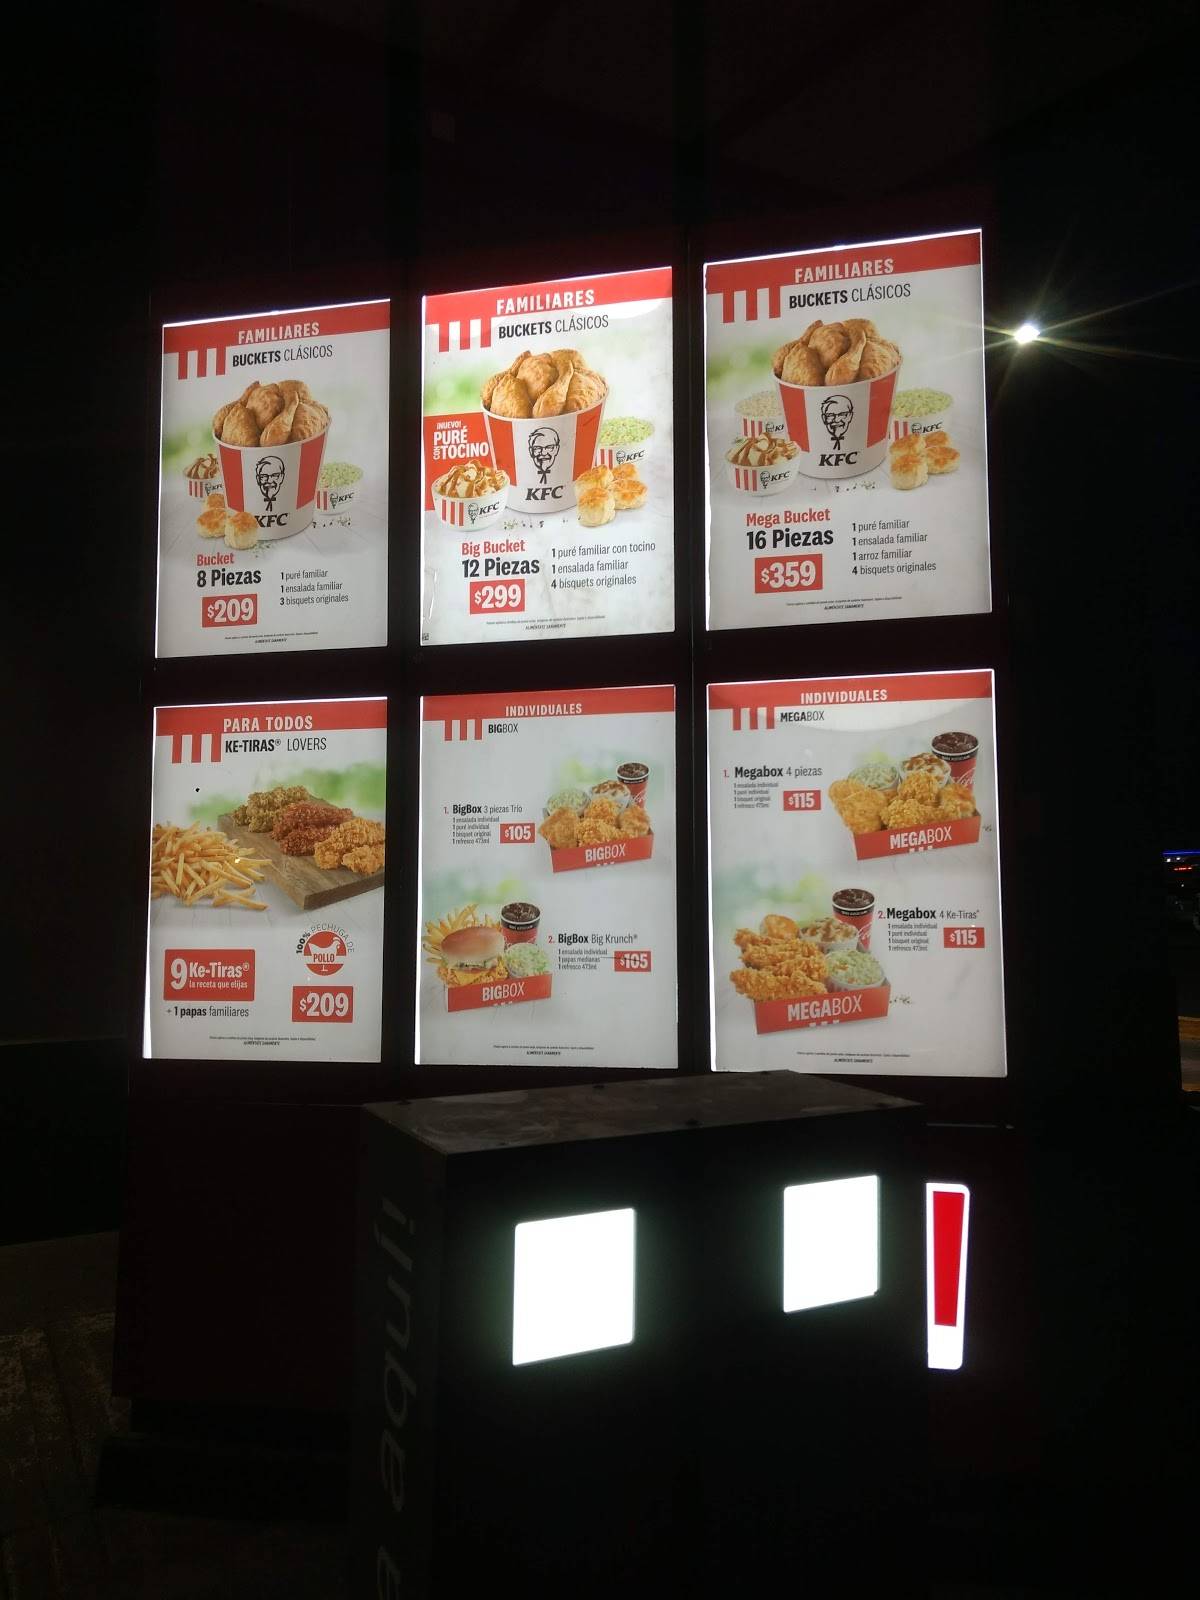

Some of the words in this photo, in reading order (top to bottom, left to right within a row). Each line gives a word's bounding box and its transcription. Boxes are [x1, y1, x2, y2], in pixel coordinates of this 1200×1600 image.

[794, 258, 894, 283] FAMILIARES
[496, 289, 595, 315] FAMILIARES
[789, 290, 848, 309] BUCKETS
[851, 283, 911, 303] CLÁSICOS
[238, 322, 320, 344] FAMILIARES
[499, 321, 552, 339] BUCKETS
[555, 314, 609, 333] CLÁSICOS
[232, 350, 281, 367] BUCKETS
[283, 345, 333, 361] CLÁSICOS
[433, 425, 468, 446] PURÉ
[921, 422, 943, 433] KFC
[433, 445, 441, 460] CON
[441, 442, 489, 460] TOCINO
[626, 450, 645, 461] KFC
[819, 452, 858, 467] KFC
[770, 471, 791, 481] KFC
[338, 492, 353, 502] KFC
[526, 485, 565, 501] KFC
[479, 502, 500, 515] KFC
[254, 513, 288, 528] KFC
[746, 513, 780, 528] Mega
[784, 508, 831, 524] Bucket
[852, 523, 856, 532] 1
[858, 520, 877, 532] puré
[878, 519, 910, 530] familiar
[746, 531, 767, 550] 16
[772, 528, 834, 549] Piezas
[852, 537, 856, 546] 1
[858, 535, 895, 546] ensalada
[896, 533, 928, 544] familiar
[461, 542, 480, 558] Big
[483, 539, 526, 554] Bucket
[552, 548, 556, 558] 1
[558, 546, 577, 559] puré
[578, 544, 610, 556] familiar
[612, 545, 627, 554] con
[629, 542, 656, 552] tocino
[852, 552, 856, 561] 1
[858, 551, 879, 561] arroz
[881, 549, 912, 559] familiar
[197, 552, 234, 566] Bucket
[552, 564, 556, 574] 1
[558, 563, 595, 574] ensalada
[596, 560, 628, 571] familiar
[280, 572, 284, 580] 1
[285, 570, 300, 581] puré
[302, 570, 328, 579] familiar
[461, 559, 480, 578] 12
[484, 558, 540, 577] Piezas
[761, 560, 816, 589] $359
[851, 566, 858, 575] 4
[860, 563, 895, 576] bisquets
[896, 562, 937, 574] originales
[197, 570, 207, 588] 8
[211, 568, 261, 587] Piezas
[550, 580, 557, 589] 4
[559, 577, 594, 590] bisquets
[596, 574, 636, 588] originales
[280, 585, 284, 593] 1
[285, 584, 315, 593] ensalada
[316, 582, 343, 591] familiar
[280, 597, 285, 606] 3
[285, 596, 314, 606] bisquets
[316, 594, 349, 604] originales
[474, 584, 522, 609] $299
[207, 598, 254, 623] $209
[800, 689, 888, 704] INDIVIDUALES
[505, 703, 583, 717] INDIVIDUALES
[780, 710, 825, 723] MEGABOX
[223, 717, 260, 733] PARA
[266, 715, 313, 731] TODOS
[488, 723, 519, 734] BIGBOX
[287, 737, 327, 751] LOVERS
[734, 765, 784, 780] Megabox
[786, 767, 792, 776] 4
[794, 767, 823, 779] piezas
[788, 793, 815, 809] $115
[444, 806, 449, 815] 1.
[452, 804, 482, 816] BigBox
[484, 805, 488, 813] 3
[489, 805, 509, 815] piezas
[504, 825, 531, 841] $105
[890, 826, 952, 850] MEGABOX
[585, 844, 626, 863] BIGBOX
[878, 911, 886, 919] 2.
[886, 907, 937, 921] Megabox
[940, 910, 944, 919] 4
[296, 932, 311, 954] 100%
[310, 923, 349, 941] PECHUGA
[548, 935, 555, 944] 2.
[558, 933, 589, 946] BigBox
[591, 934, 603, 945] Big
[949, 929, 977, 945] $115
[313, 953, 335, 963] POLLO
[620, 953, 648, 969] $105
[170, 959, 188, 990] 9
[189, 979, 196, 988] la
[196, 980, 216, 989] receta
[217, 981, 231, 990] que
[231, 979, 248, 990] elijas
[482, 982, 525, 1001] BIGBOX
[174, 1006, 179, 1017] 1
[180, 1007, 207, 1019] papas
[209, 1006, 249, 1017] familiares
[300, 992, 349, 1017] $209
[787, 994, 862, 1022] MEGABOX
